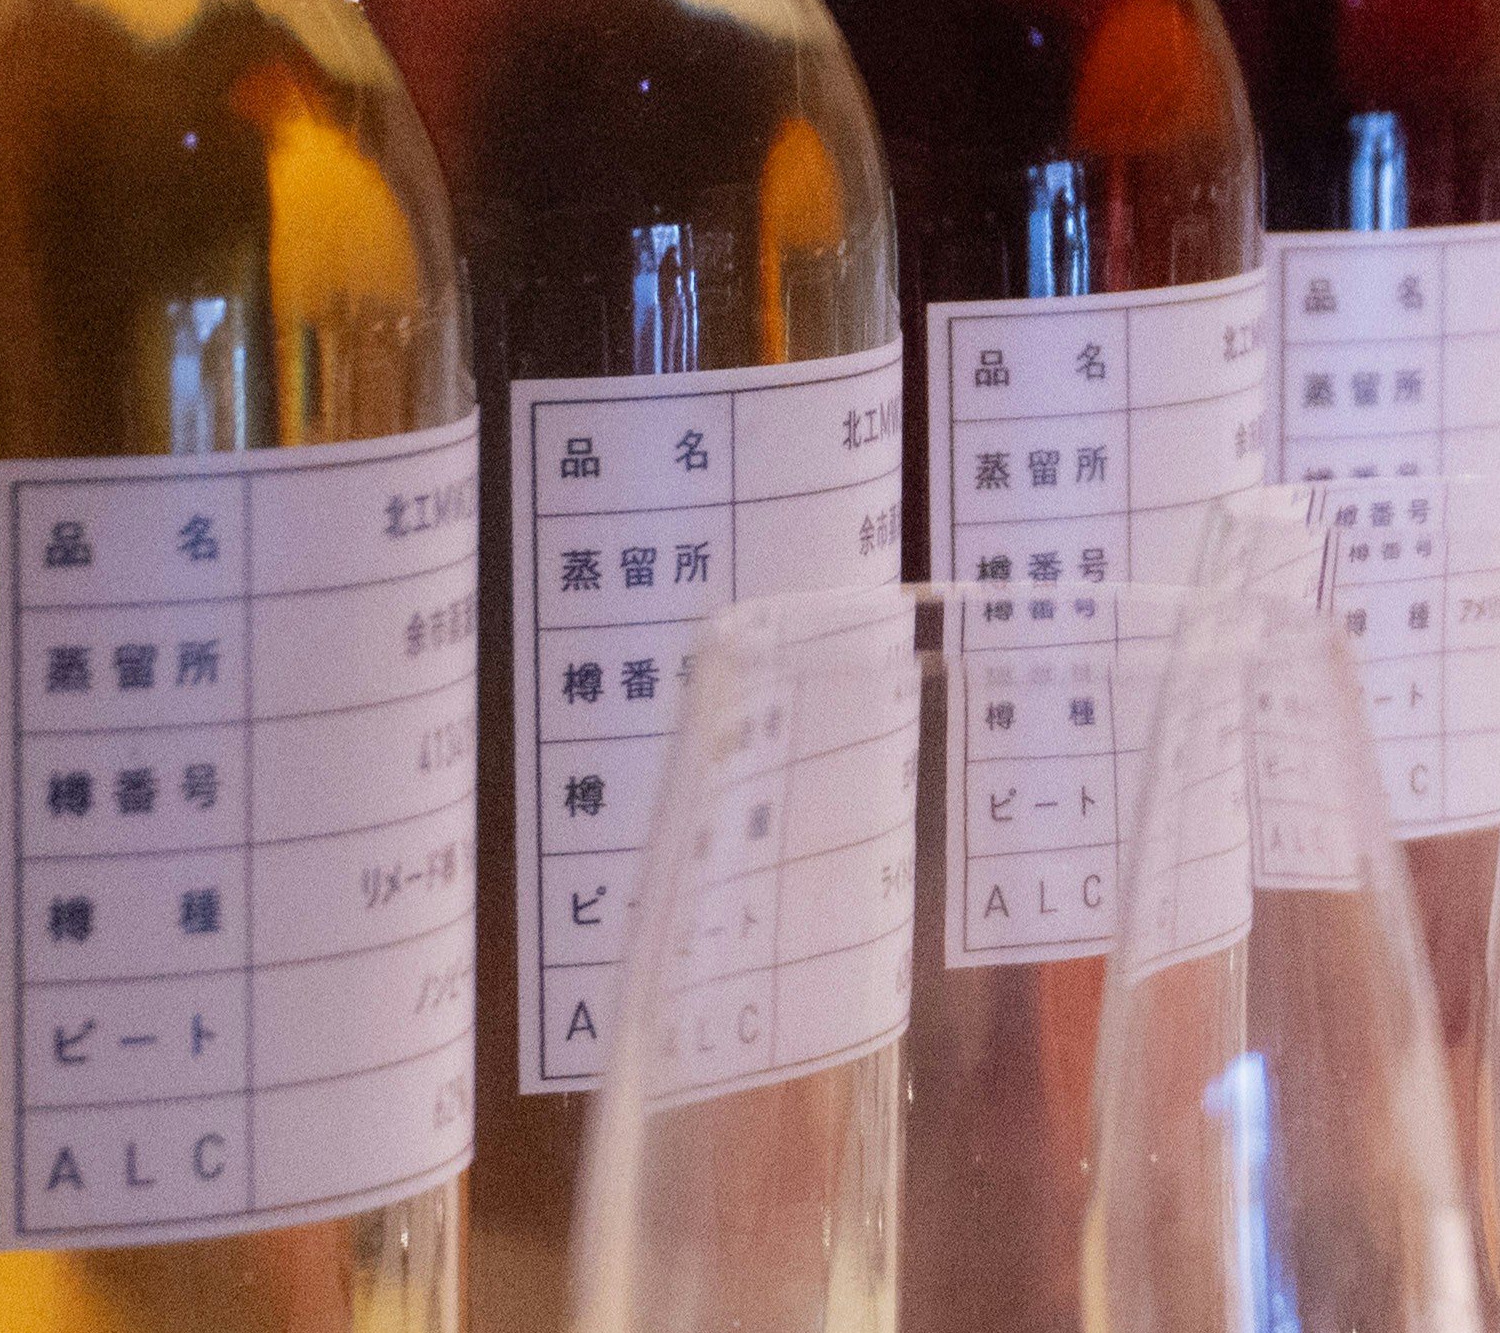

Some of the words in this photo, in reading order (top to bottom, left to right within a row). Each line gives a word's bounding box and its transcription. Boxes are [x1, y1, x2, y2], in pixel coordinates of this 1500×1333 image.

[973, 343, 1109, 388] 品名
[559, 429, 711, 481] 品名
[973, 445, 1110, 492] 蒸留所
[43, 516, 221, 571] 品名
[559, 539, 712, 594] 蒸留所
[45, 637, 221, 694] 蒸留所
[46, 763, 220, 817] 樽番号
[988, 785, 1098, 823] ピート
[982, 872, 1102, 920] ALC
[53, 1013, 216, 1067] ピート
[46, 1132, 226, 1193] ALC
